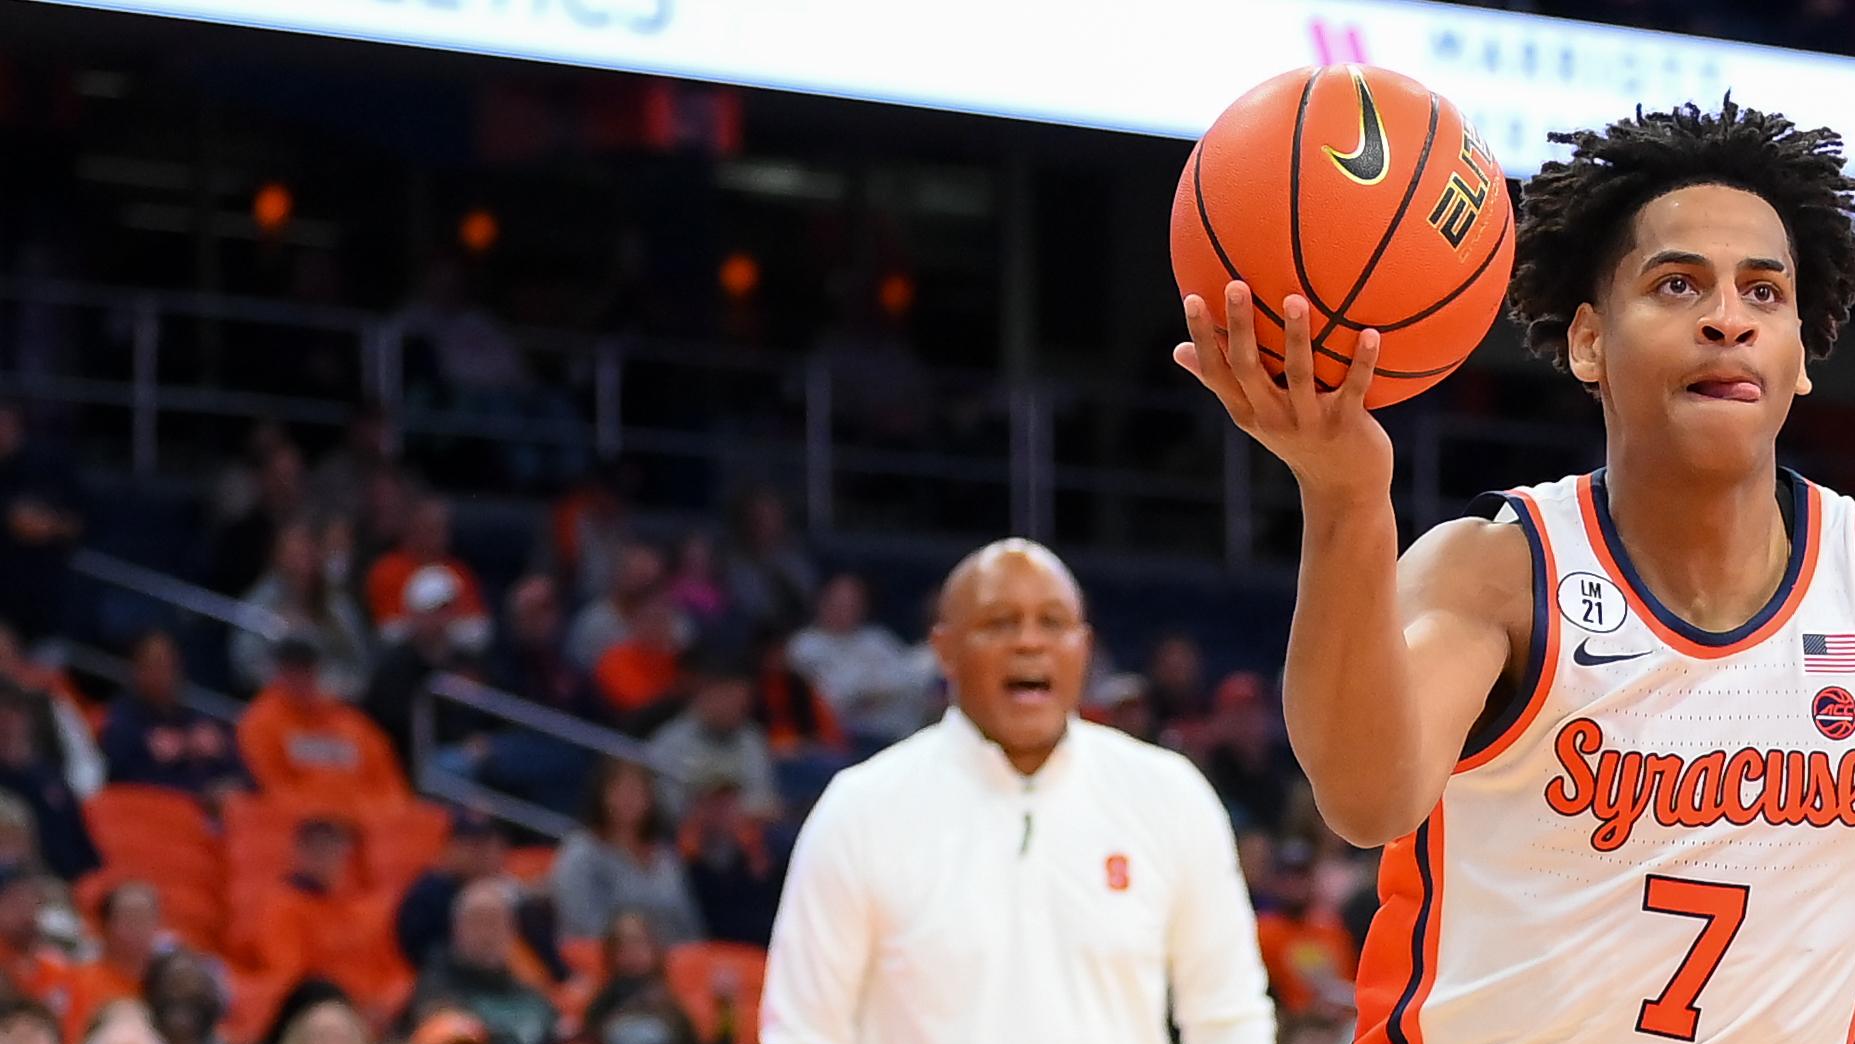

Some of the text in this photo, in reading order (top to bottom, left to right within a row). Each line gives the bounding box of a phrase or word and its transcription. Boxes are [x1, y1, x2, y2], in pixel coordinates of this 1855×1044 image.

[1427, 117, 1495, 252] ELITE
[1581, 579, 1602, 599] LM
[1582, 599, 1603, 625] 21
[1105, 854, 1129, 892] S
[1634, 873, 1751, 1043] 7
